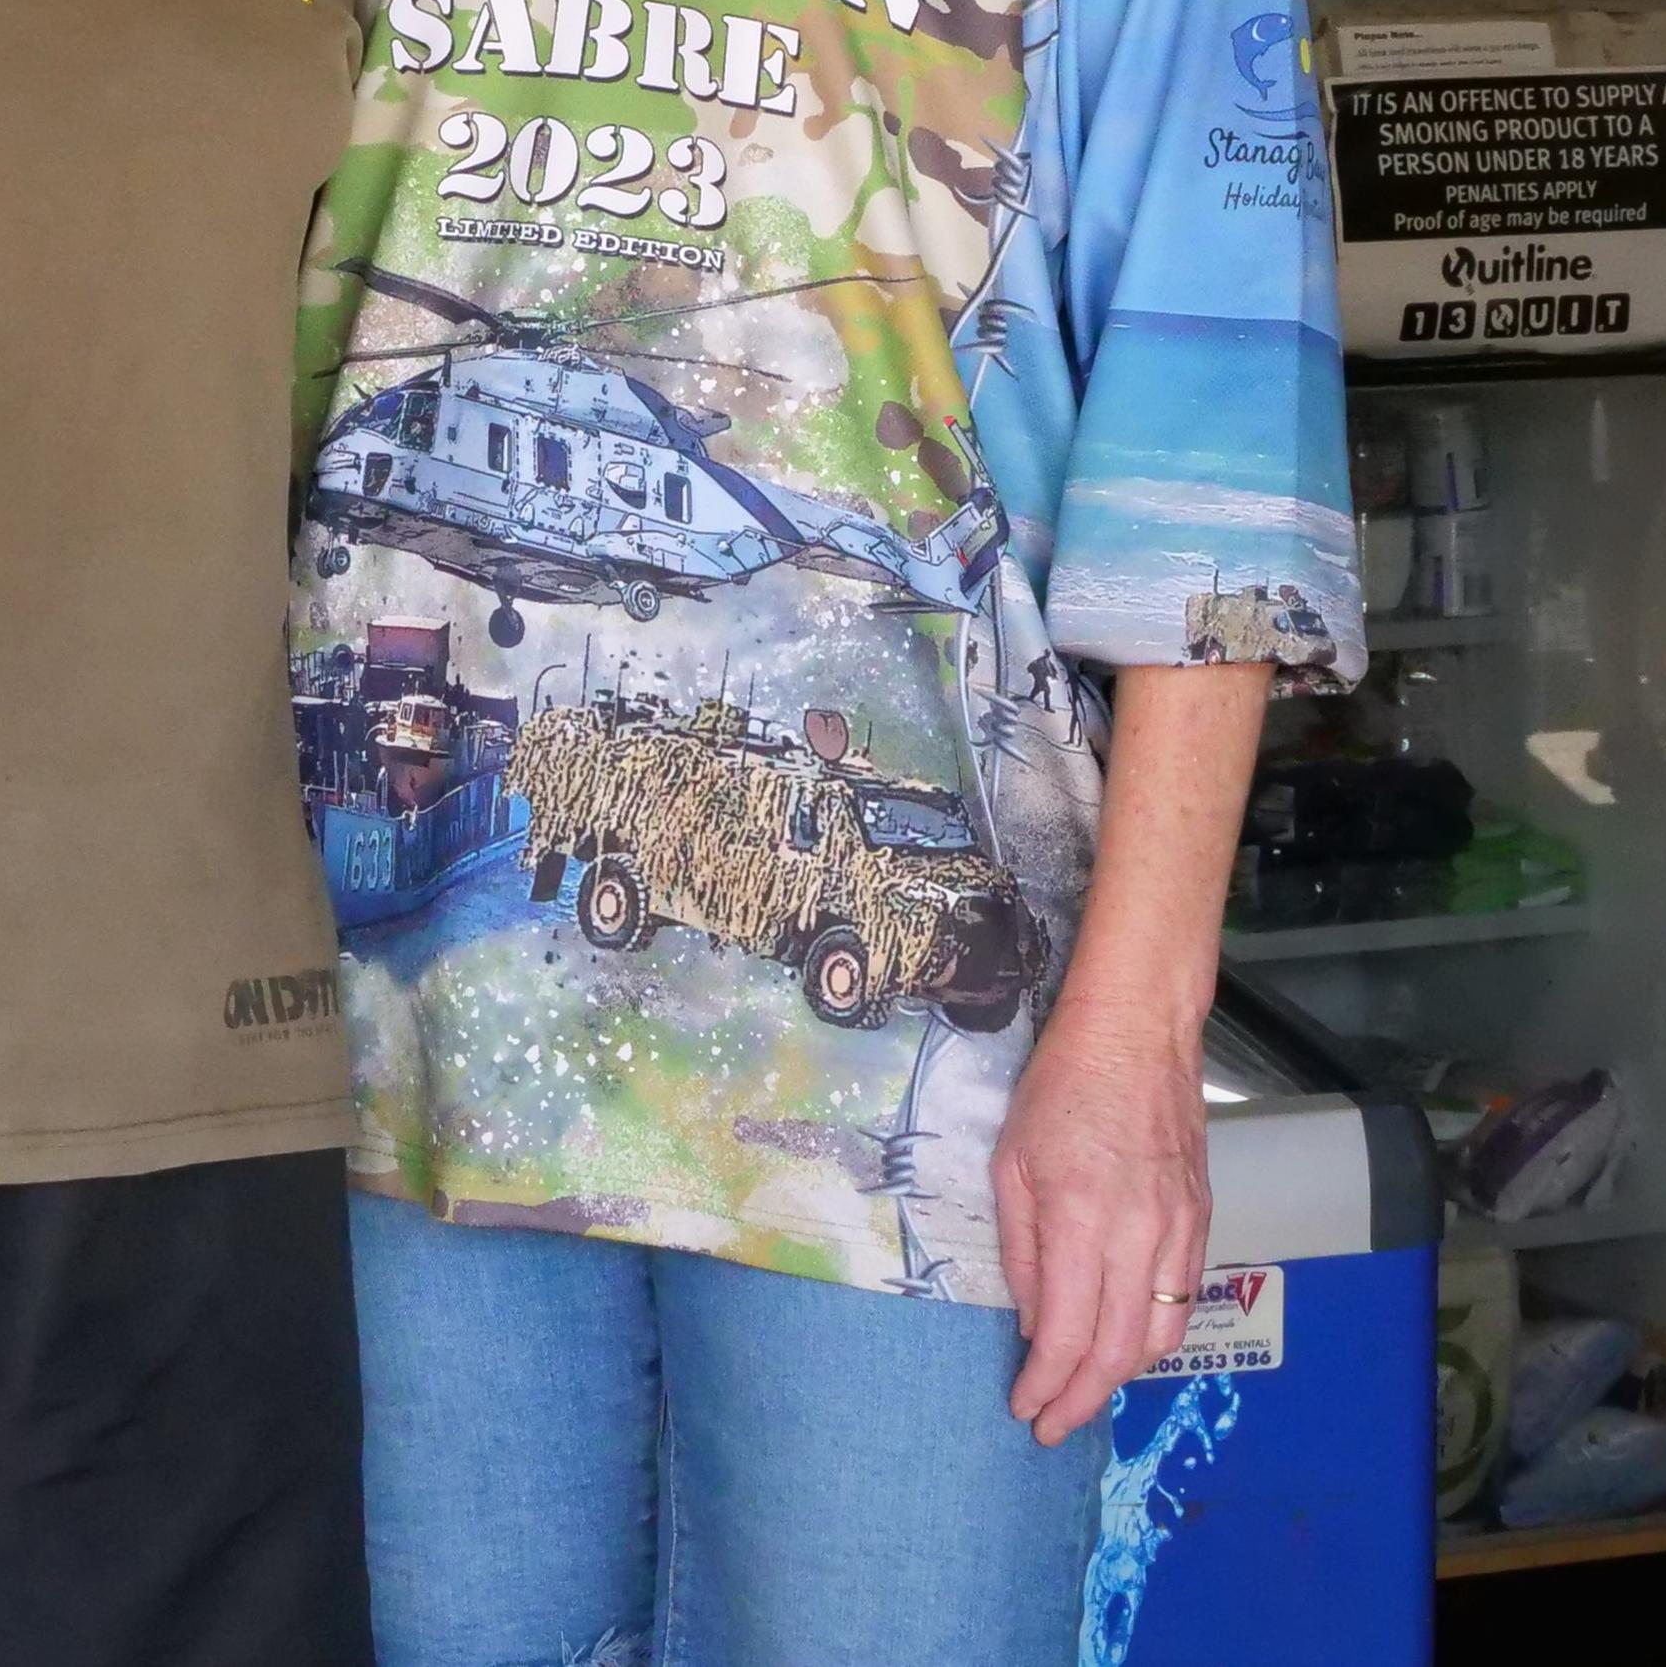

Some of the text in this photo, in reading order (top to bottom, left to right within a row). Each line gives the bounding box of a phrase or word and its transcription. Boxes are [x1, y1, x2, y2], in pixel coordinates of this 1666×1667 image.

[1352, 93, 1372, 116] IT
[1376, 91, 1397, 116] IS
[1402, 90, 1434, 114] AN
[1440, 87, 1535, 113] OFFENCE
[1541, 85, 1569, 109] TO
[1576, 83, 1657, 109] SUPPLY
[1379, 113, 1654, 147] SMOKING PRODUCT TO A
[436, 110, 728, 230] 2023
[1203, 126, 1303, 184] Stanag
[1377, 143, 1660, 177] PERSON UNDER 18 YEARS
[1445, 180, 1598, 205] PENALTIES APPLY
[1394, 202, 1648, 233] Proof of age may be required
[436, 216, 725, 272] LIMITED EDITION
[1441, 243, 1594, 295] Quitline
[341, 826, 393, 892] 1633
[1181, 1339, 1272, 1354] SERVICE RENTALS
[1188, 1353, 1228, 1371] 653
[1233, 1351, 1272, 1368] 986
